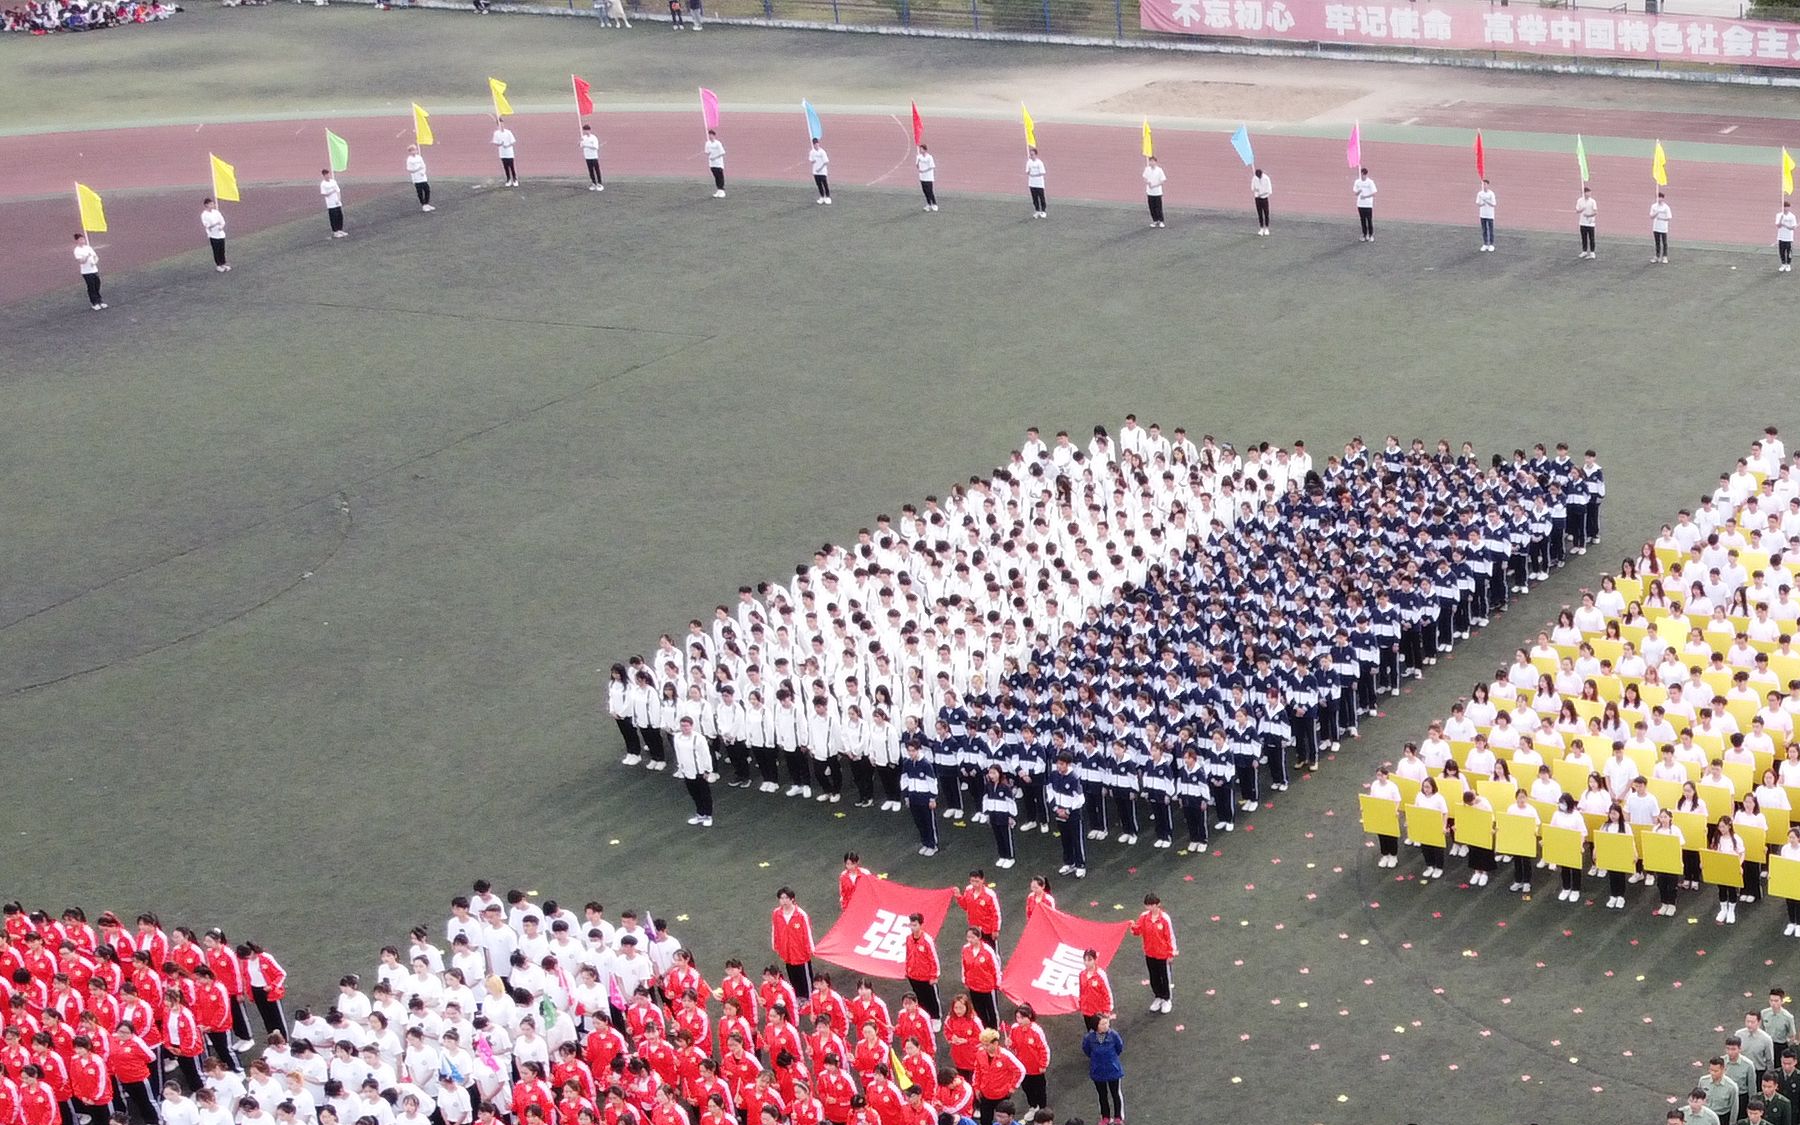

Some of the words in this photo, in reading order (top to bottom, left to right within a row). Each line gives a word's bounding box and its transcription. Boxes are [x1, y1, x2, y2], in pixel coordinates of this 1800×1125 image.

[1171, 0, 1295, 32] 不忘初心
[1325, 4, 1452, 40] 牢记使命
[854, 908, 912, 963] 强
[1031, 942, 1087, 997] 最
